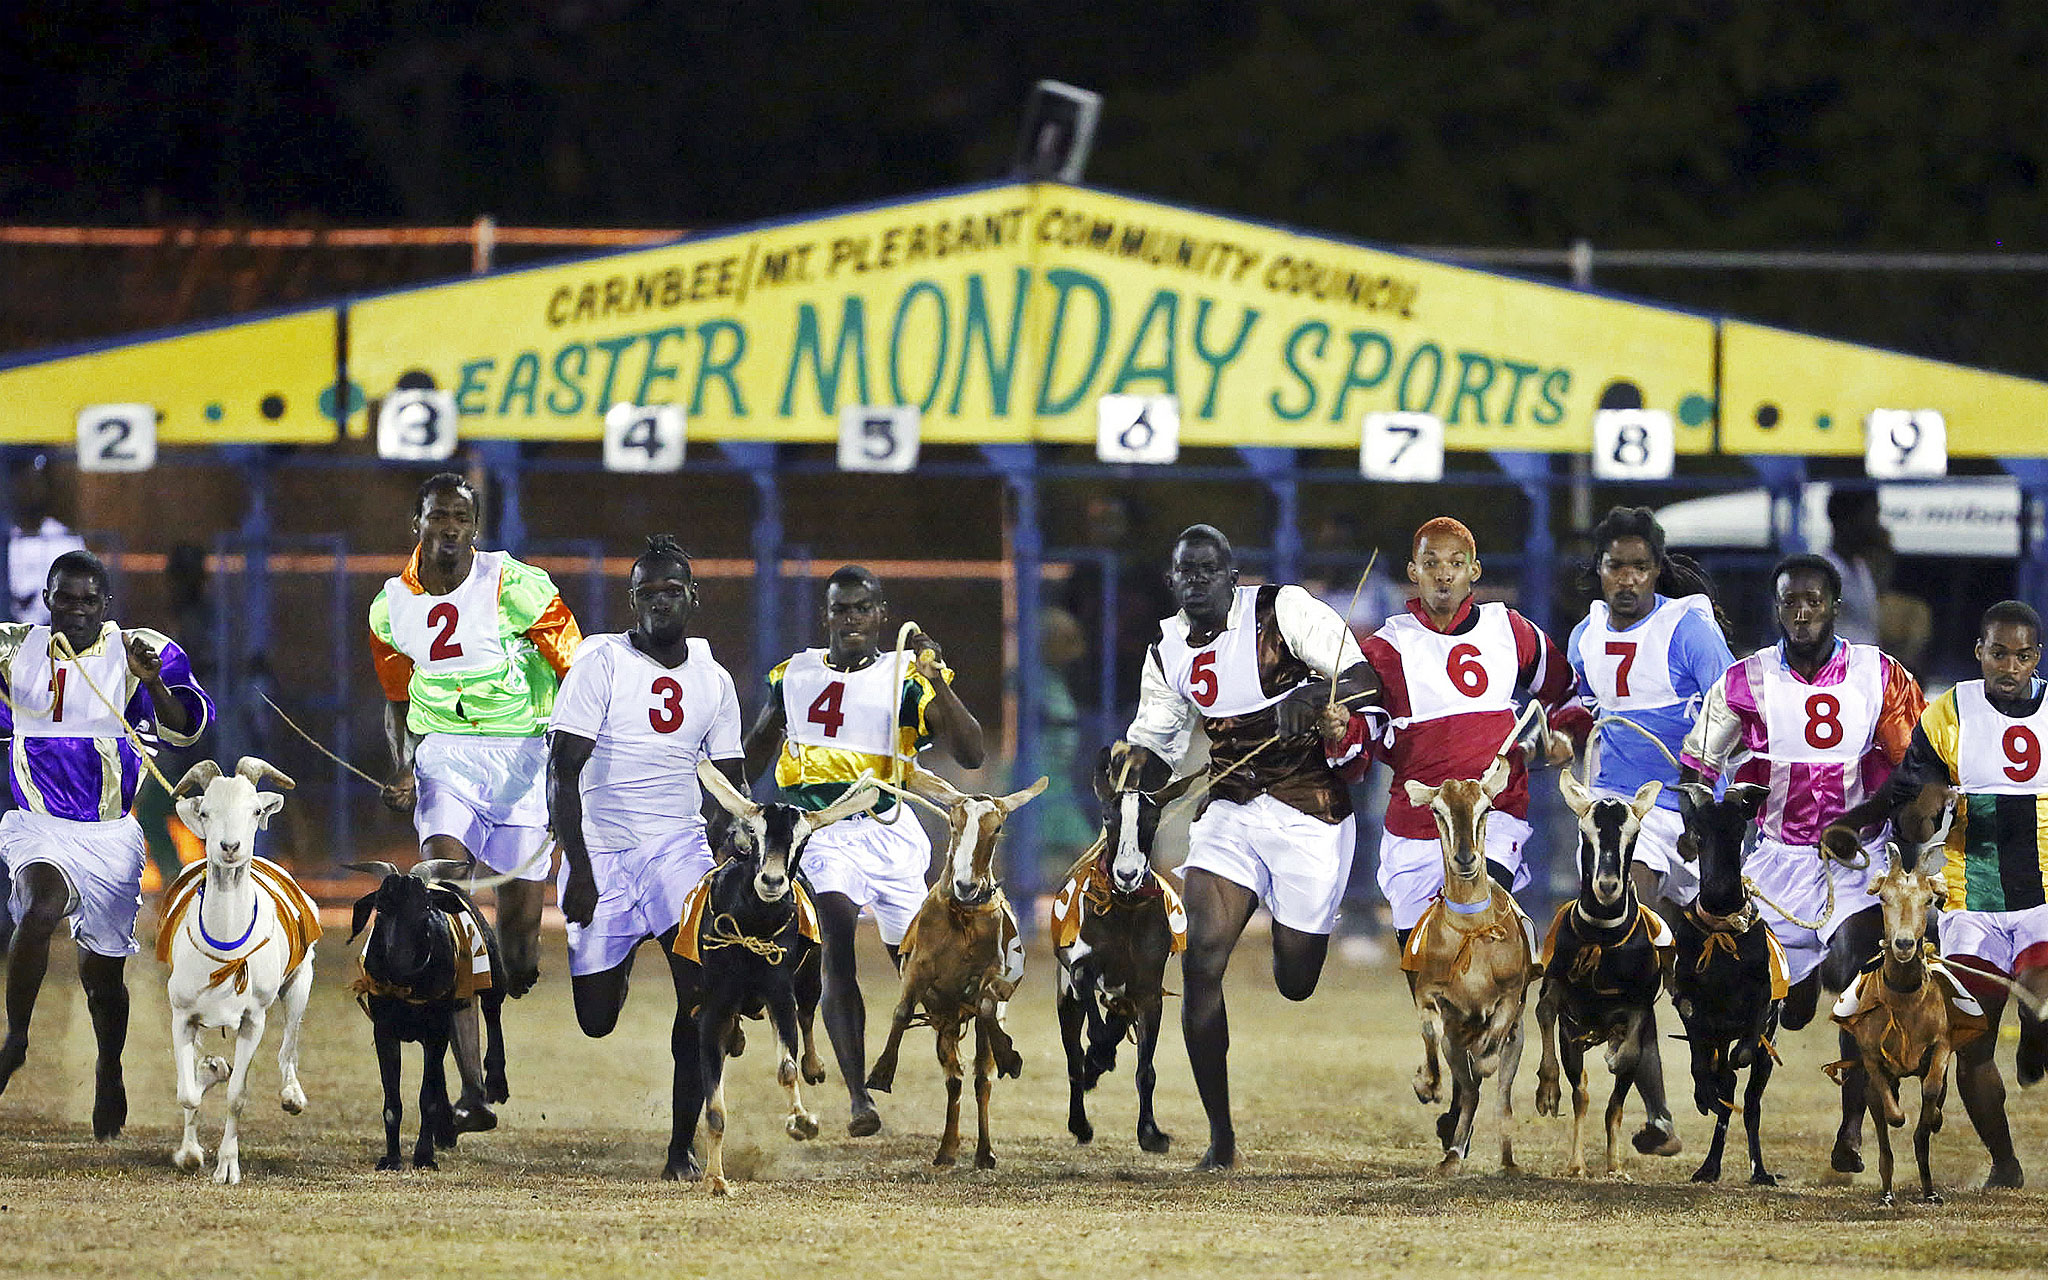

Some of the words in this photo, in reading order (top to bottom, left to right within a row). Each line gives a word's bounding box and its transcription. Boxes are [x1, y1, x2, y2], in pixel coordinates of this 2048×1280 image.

[827, 206, 1028, 277] PLEASANT
[1035, 208, 1260, 283] COMMUNITY
[1263, 253, 1418, 320] COUNCIL
[455, 318, 748, 419] EASTER
[777, 266, 1260, 420] MONDAY
[1268, 319, 1572, 426] SPORTS
[95, 419, 134, 461] 2
[397, 401, 442, 448] 3
[621, 417, 666, 460] 4
[861, 418, 899, 461] 5
[1118, 406, 1155, 451] 6
[1385, 425, 1421, 465] 7
[1612, 424, 1649, 466] 8
[1889, 420, 1921, 466] 9
[427, 602, 464, 662] 2
[48, 668, 67, 723] 1
[1190, 650, 1219, 708] 5
[1446, 643, 1489, 698] 6
[1604, 641, 1638, 697] 7
[648, 676, 685, 734] 3
[807, 681, 846, 738] 4
[1804, 694, 1844, 750] 8
[2001, 725, 2042, 783] 9
